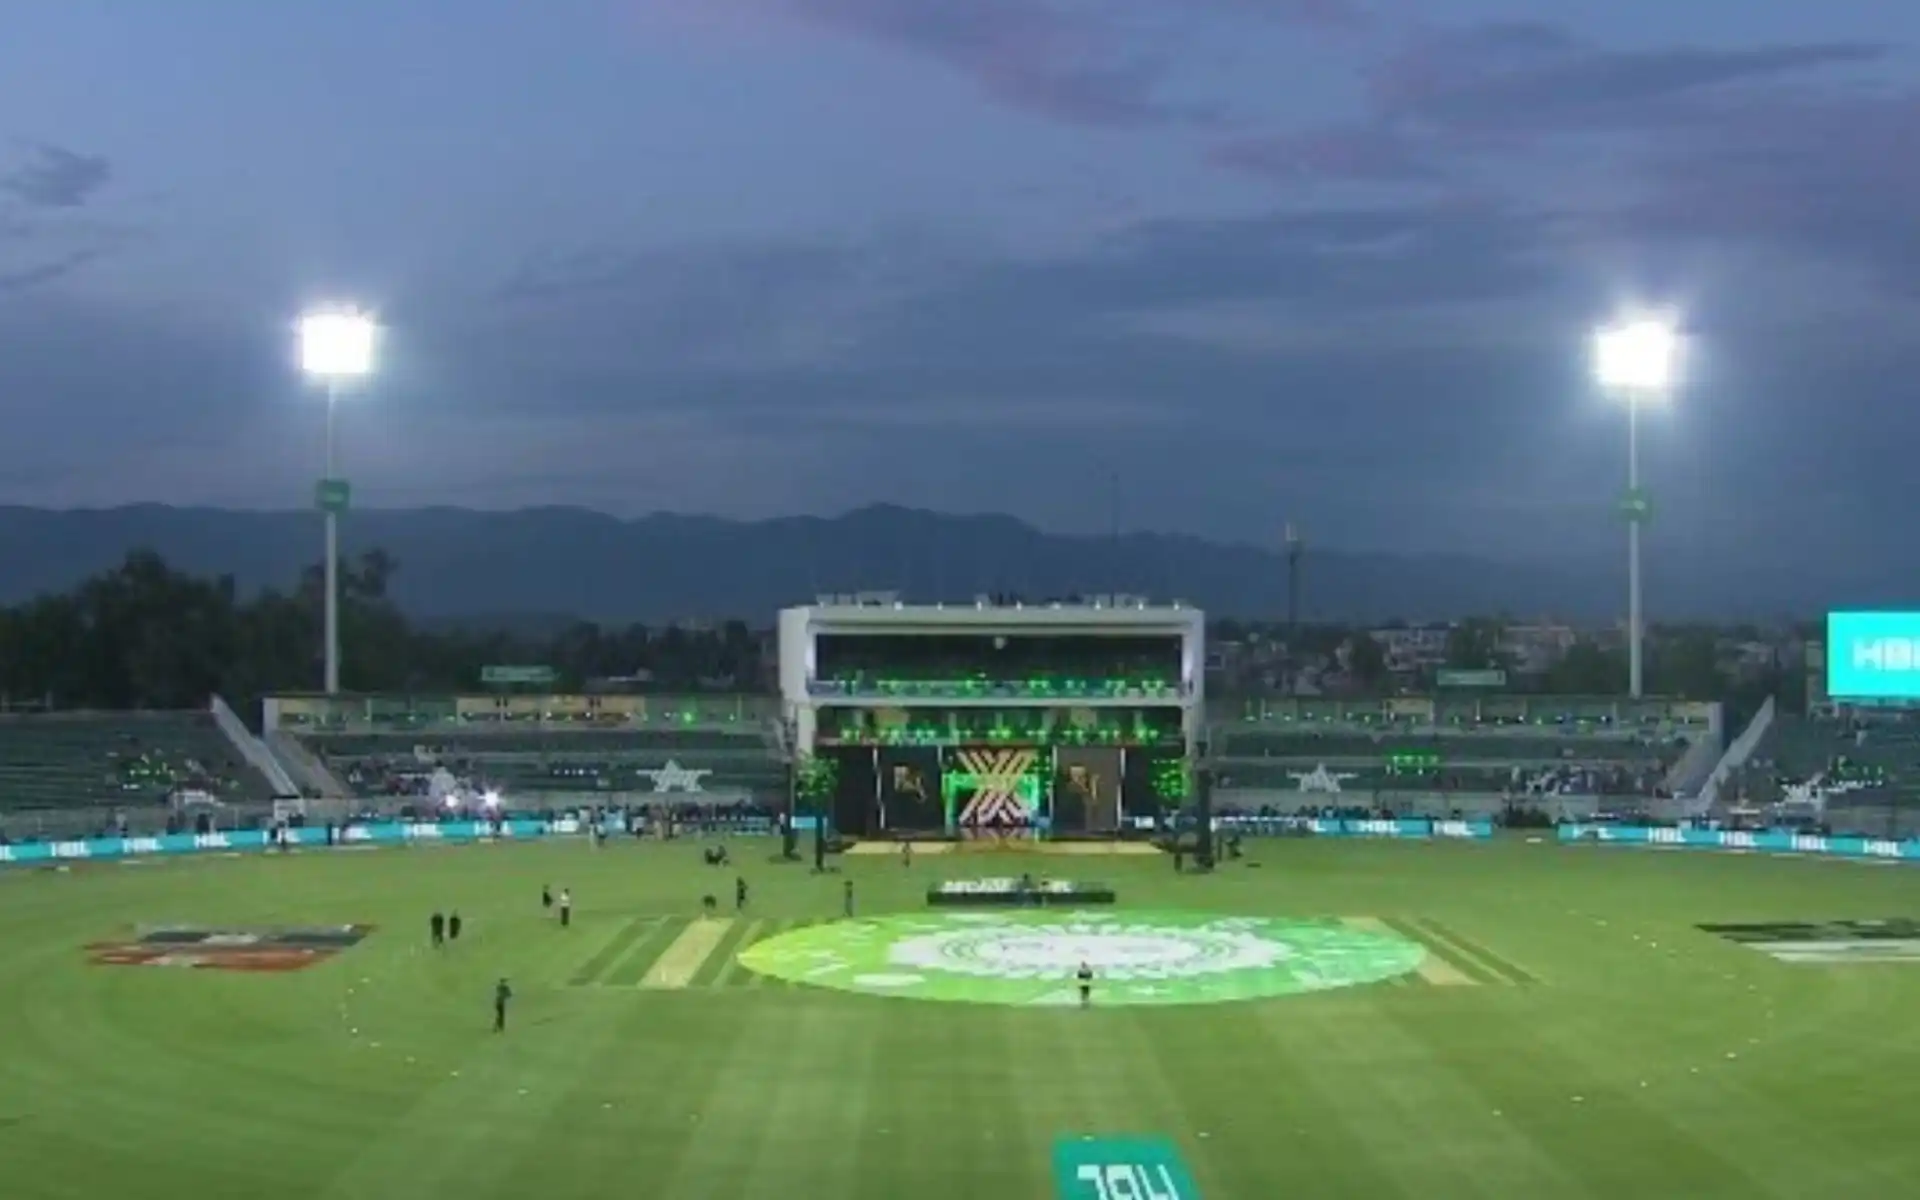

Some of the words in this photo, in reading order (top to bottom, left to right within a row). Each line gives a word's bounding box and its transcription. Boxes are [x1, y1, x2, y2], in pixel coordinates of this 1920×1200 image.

[1359, 820, 1402, 833] HBL
[1648, 827, 1688, 843] HBL
[1719, 830, 1758, 847] HBL
[1790, 834, 1830, 851] HBL
[1863, 840, 1904, 857] HBL
